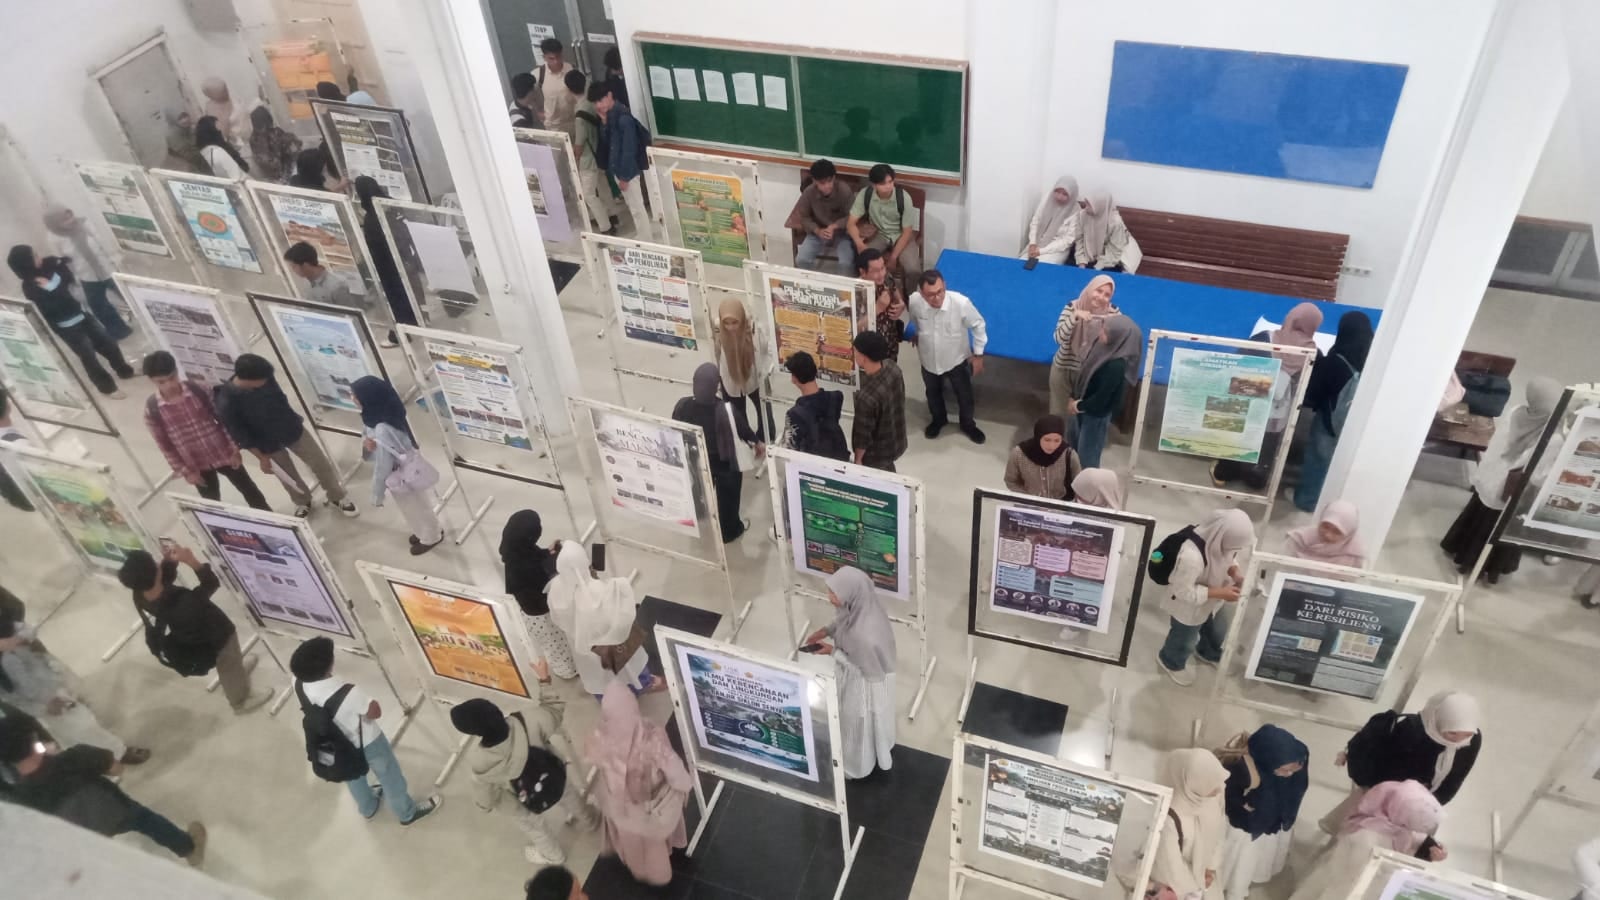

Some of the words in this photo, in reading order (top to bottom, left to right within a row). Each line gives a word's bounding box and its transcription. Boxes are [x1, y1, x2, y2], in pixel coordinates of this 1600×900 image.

[1296, 609, 1314, 619] KE
[1315, 613, 1382, 631] RESILIENSI
[1303, 603, 1334, 615] DARI
[1337, 609, 1379, 623] RISIKO
[704, 671, 724, 682] ILMU
[712, 680, 728, 688] DAN
[730, 683, 784, 703] LINGKUNGAN
